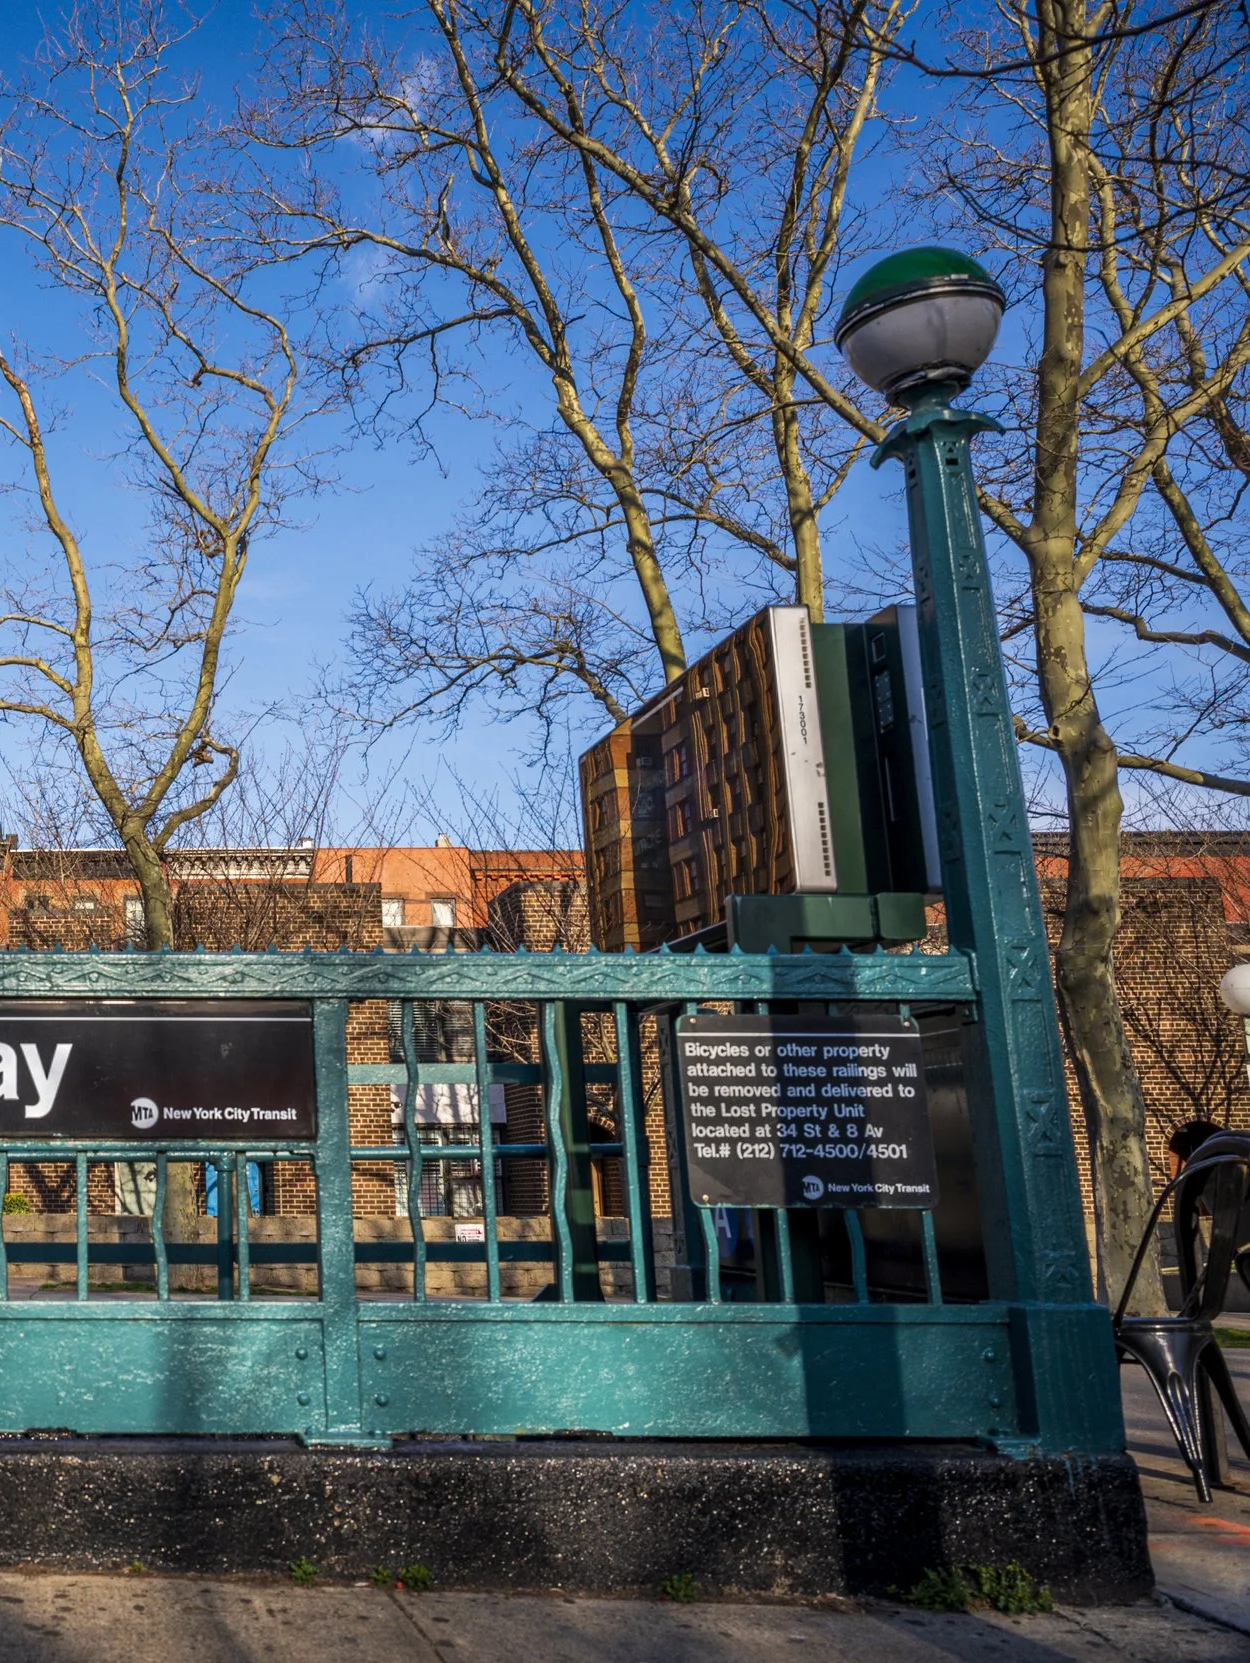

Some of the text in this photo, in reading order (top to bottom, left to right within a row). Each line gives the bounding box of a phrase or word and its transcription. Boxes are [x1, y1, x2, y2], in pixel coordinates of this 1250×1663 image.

[798, 695, 808, 745] 173001
[684, 1042, 890, 1060] Bicycles or other property
[686, 1062, 918, 1080] attached to these railings will
[688, 1082, 916, 1098] be removed and delivered to
[163, 1107, 192, 1120] New
[193, 1107, 223, 1120] York
[224, 1107, 251, 1123] City
[251, 1107, 298, 1120] Transit
[690, 1102, 866, 1120] the Lost Property Unit
[691, 1122, 884, 1138] located at 34 St & 8 Av
[693, 1142, 908, 1160] Tel.# (212) 712-4500/4501
[828, 1183, 851, 1193] New
[851, 1183, 874, 1193] York
[875, 1183, 895, 1195] City
[895, 1183, 931, 1194] Transit
